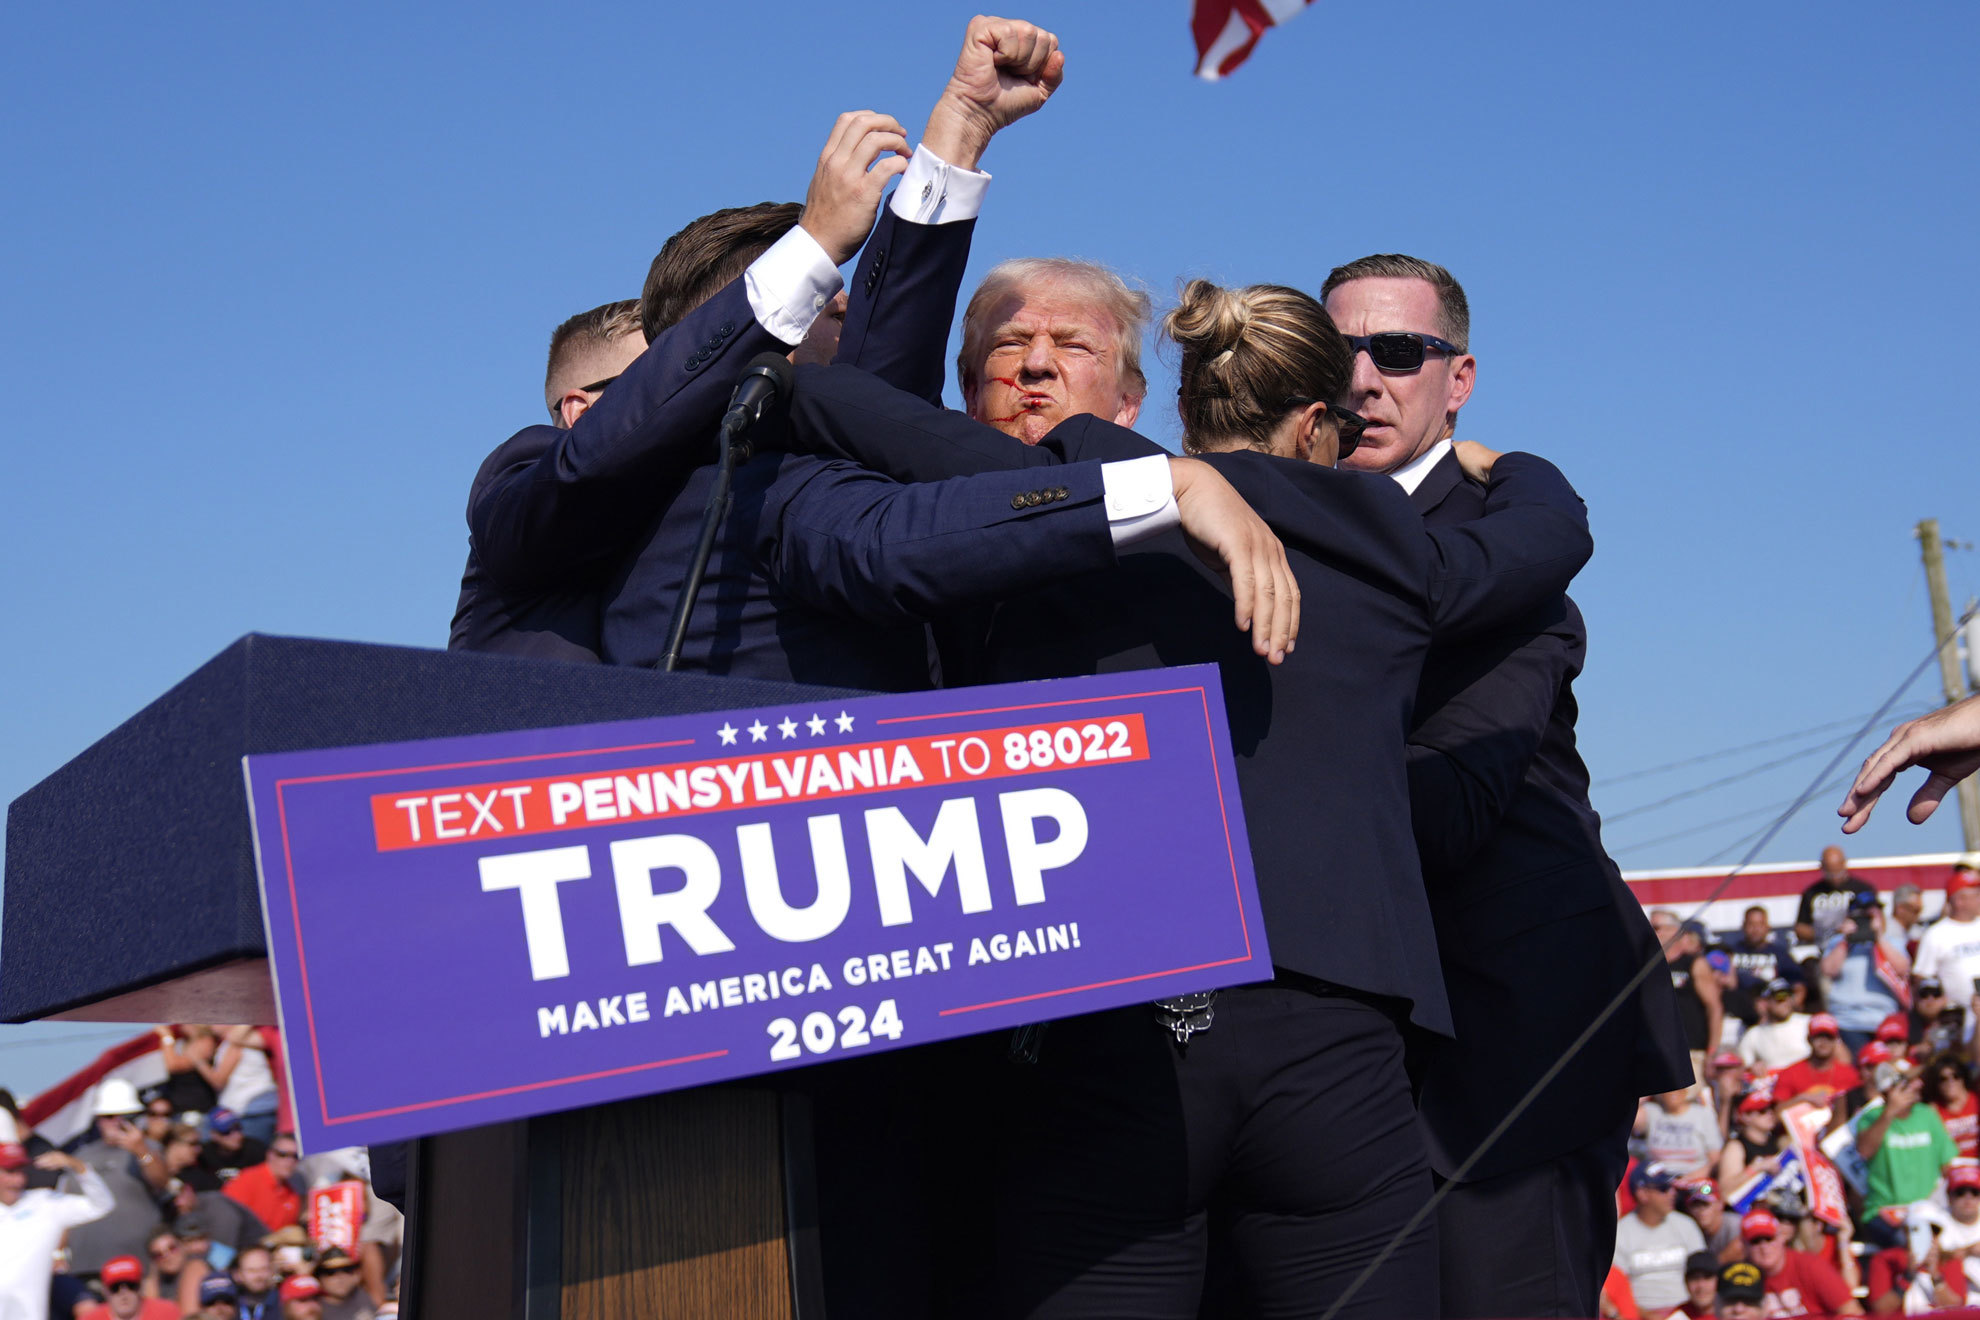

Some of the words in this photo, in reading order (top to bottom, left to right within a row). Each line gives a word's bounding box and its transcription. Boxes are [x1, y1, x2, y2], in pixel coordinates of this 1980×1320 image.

[395, 785, 532, 842] TEXT
[548, 744, 925, 825] PENNSYLVANIA
[930, 736, 991, 778] TO
[1003, 721, 1133, 771] 88022
[477, 787, 1089, 982] TRUMP
[537, 991, 651, 1038] MAKE
[663, 963, 833, 1018] AMERICA
[842, 942, 954, 986] GREAT
[968, 922, 1081, 966] AGAIN!
[766, 998, 904, 1062] 2024
